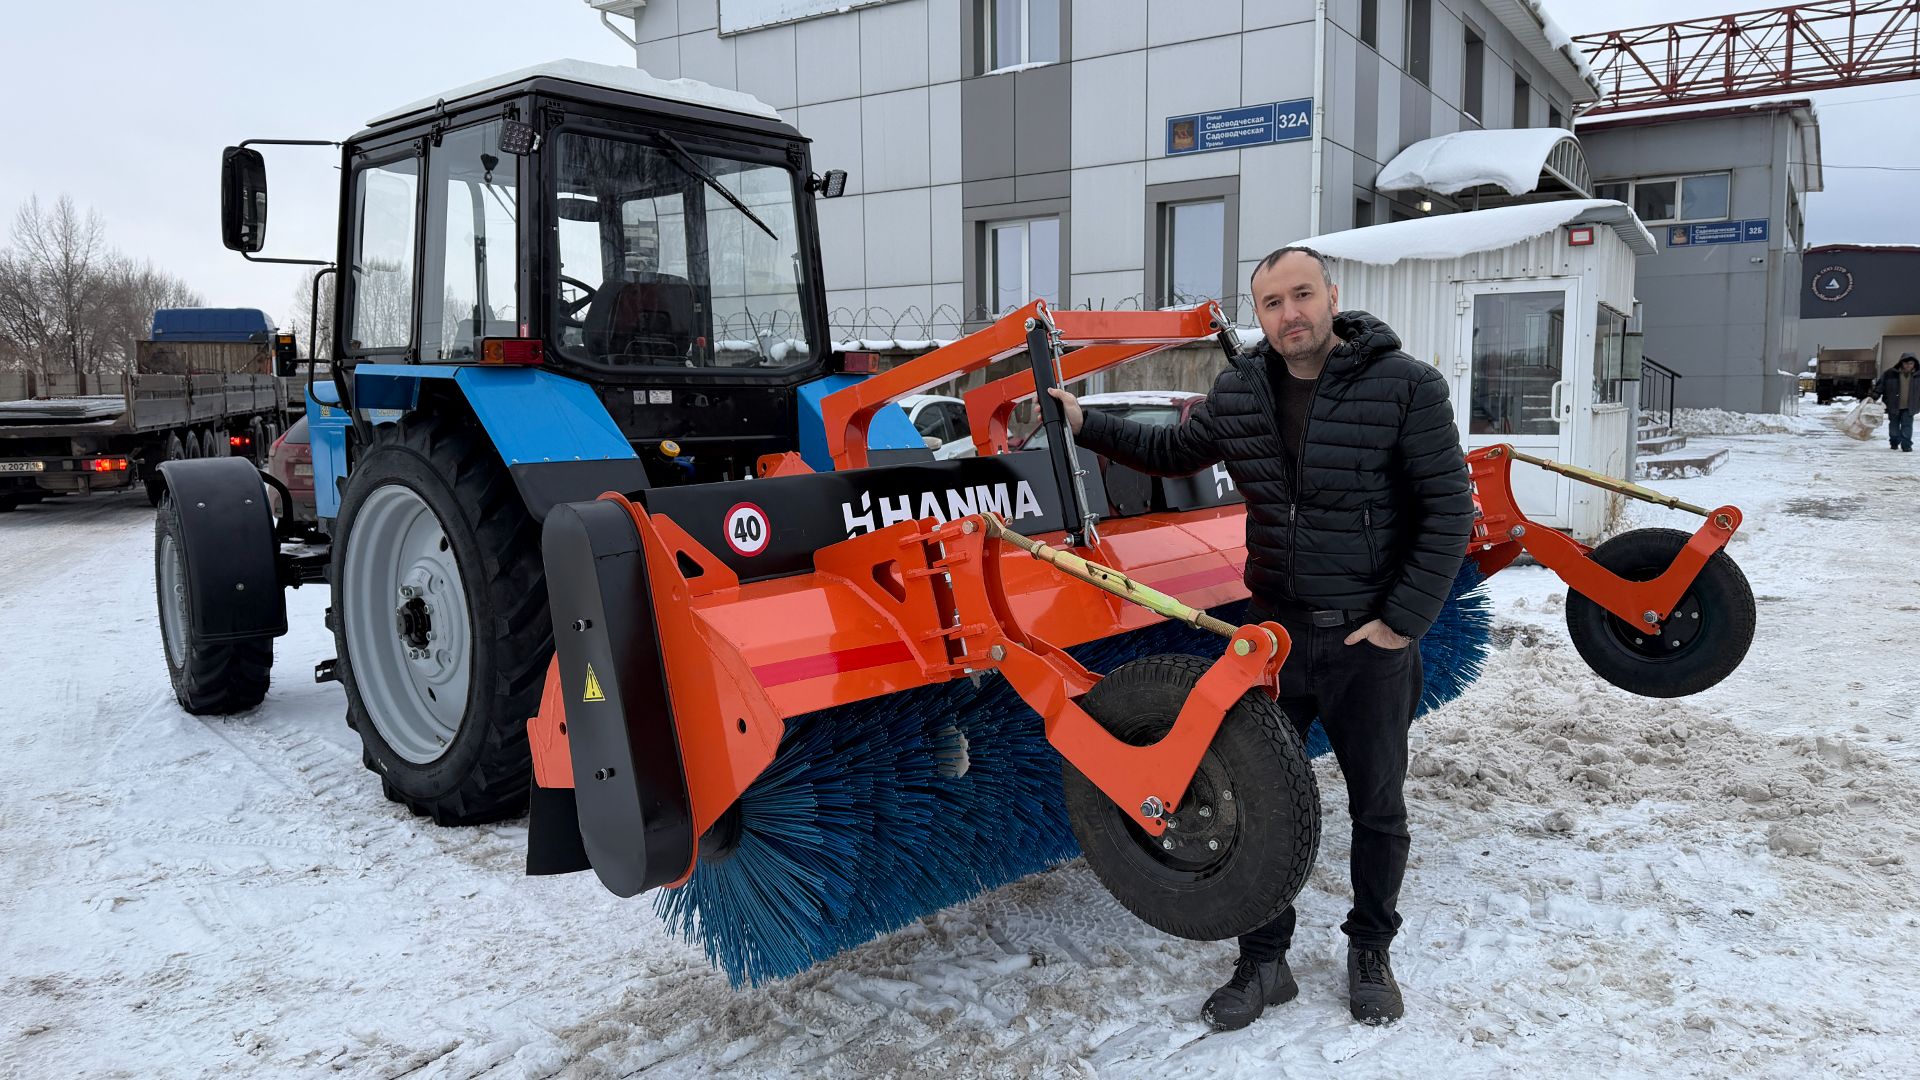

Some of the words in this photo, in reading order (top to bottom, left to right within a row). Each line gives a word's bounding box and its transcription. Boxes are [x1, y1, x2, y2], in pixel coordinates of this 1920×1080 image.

[1205, 116, 1264, 130] Садоводческая
[1279, 111, 1309, 129] 32А
[1205, 127, 1264, 140] Садоводческая
[1748, 227, 1762, 235] 32Б
[9, 462, 29, 471] 2027
[879, 480, 1043, 529] HANMA
[734, 514, 760, 543] 40
